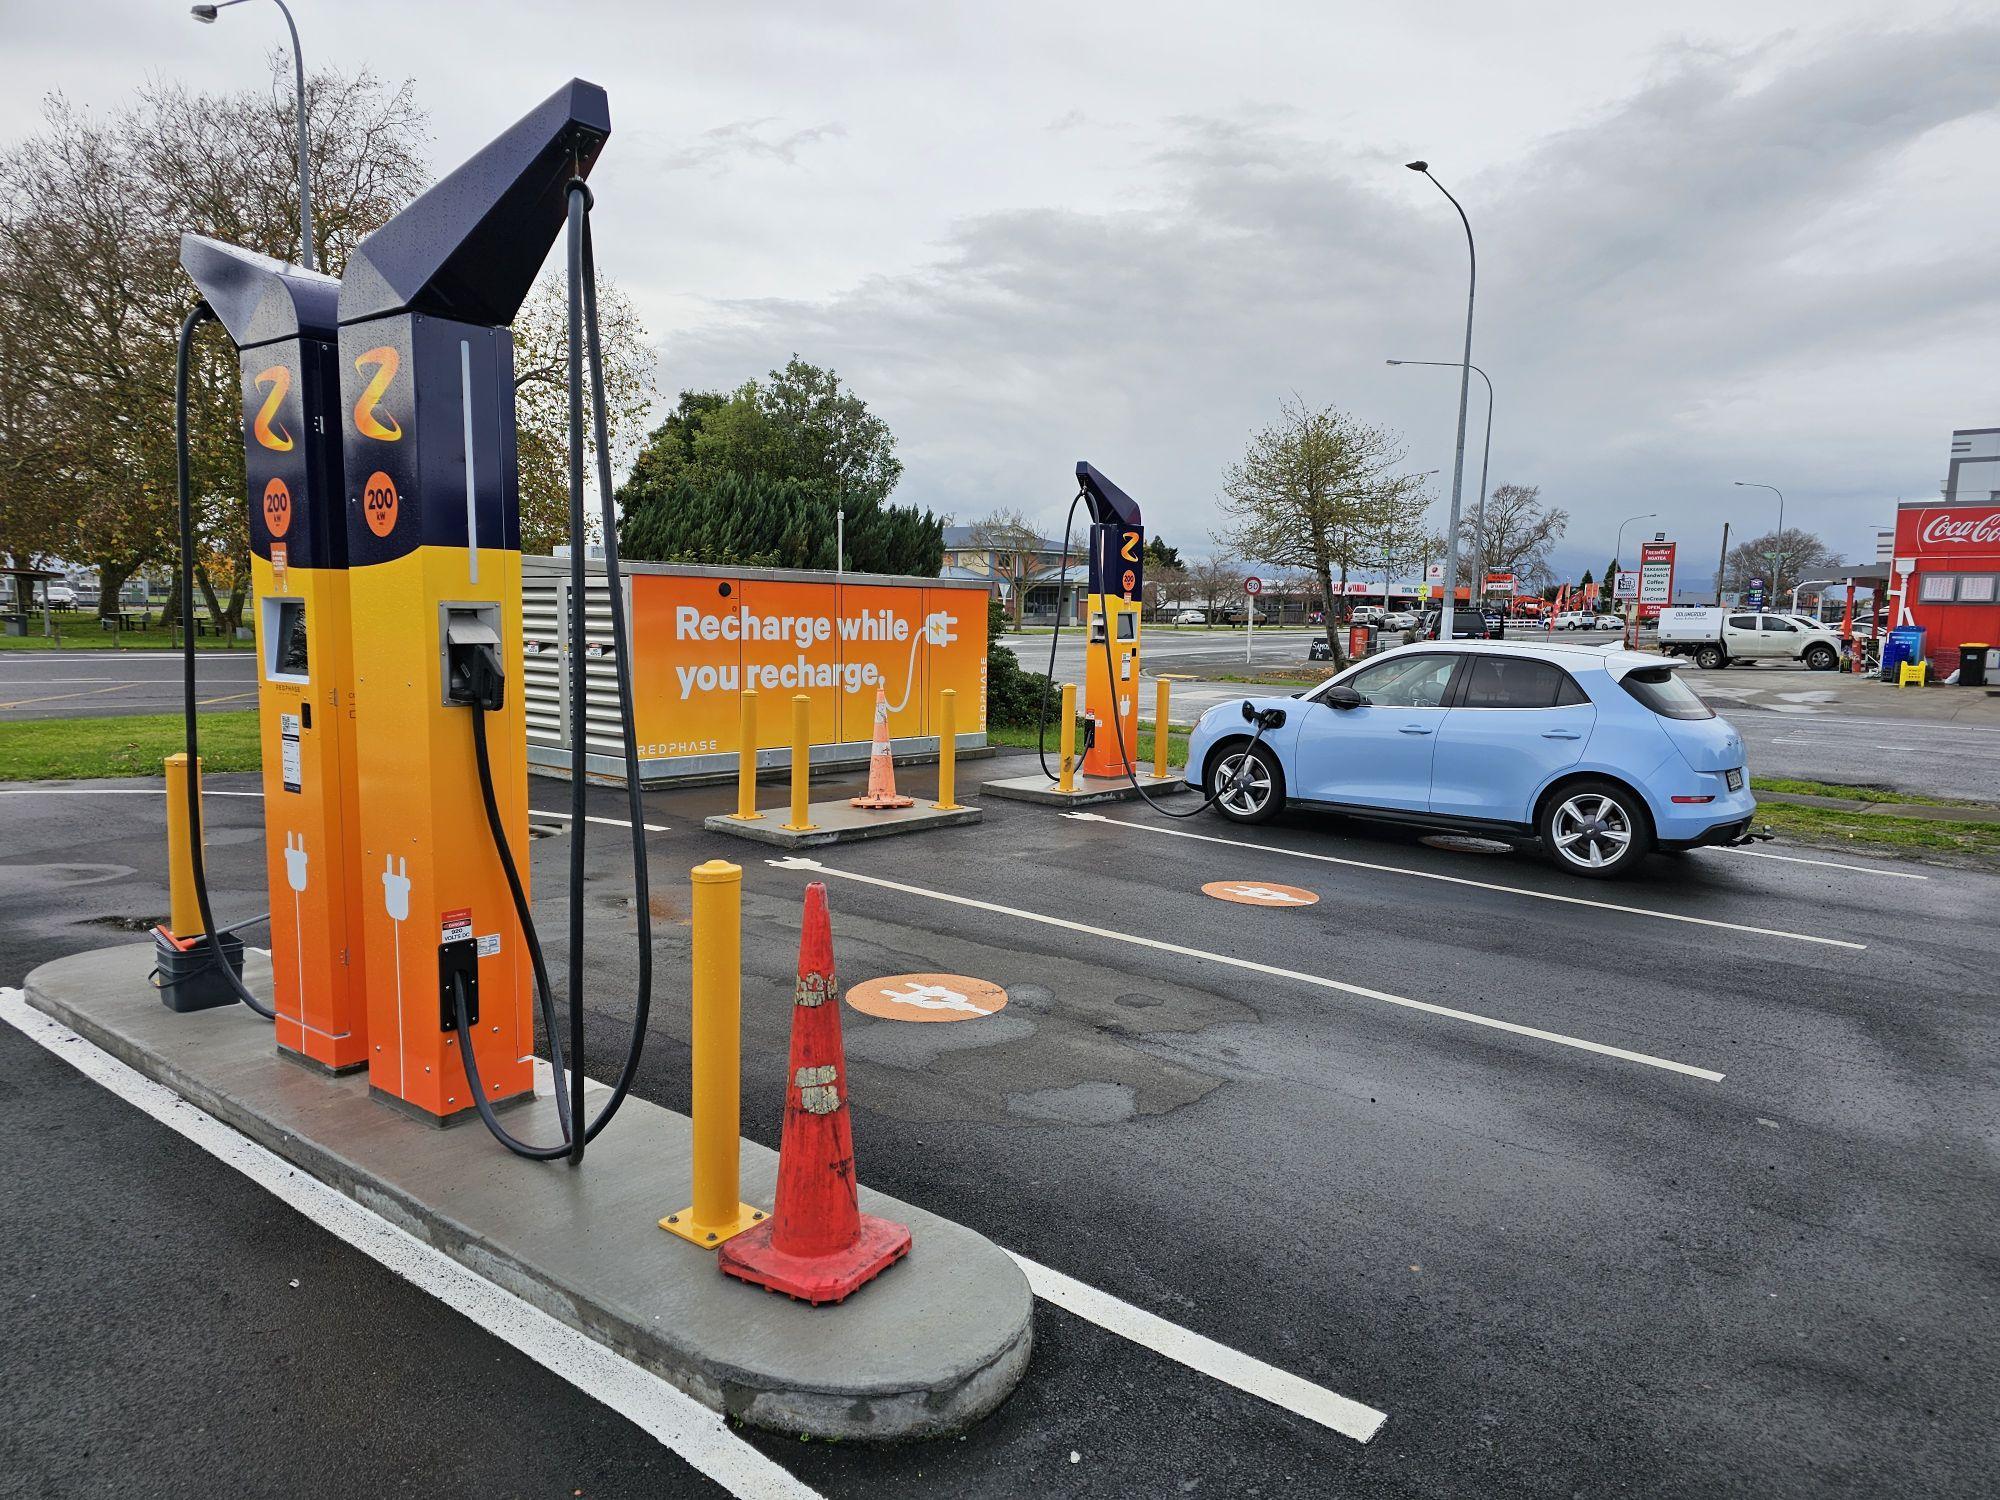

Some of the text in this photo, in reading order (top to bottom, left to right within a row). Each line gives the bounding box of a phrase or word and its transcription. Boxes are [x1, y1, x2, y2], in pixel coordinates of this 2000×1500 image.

[267, 492, 288, 513] 200
[368, 488, 393, 510] 200
[1248, 582, 1258, 590] 50
[676, 605, 909, 648] Recharge while
[675, 665, 739, 700] you
[637, 739, 717, 756] REDPHASE
[444, 933, 461, 941] VOLTS
